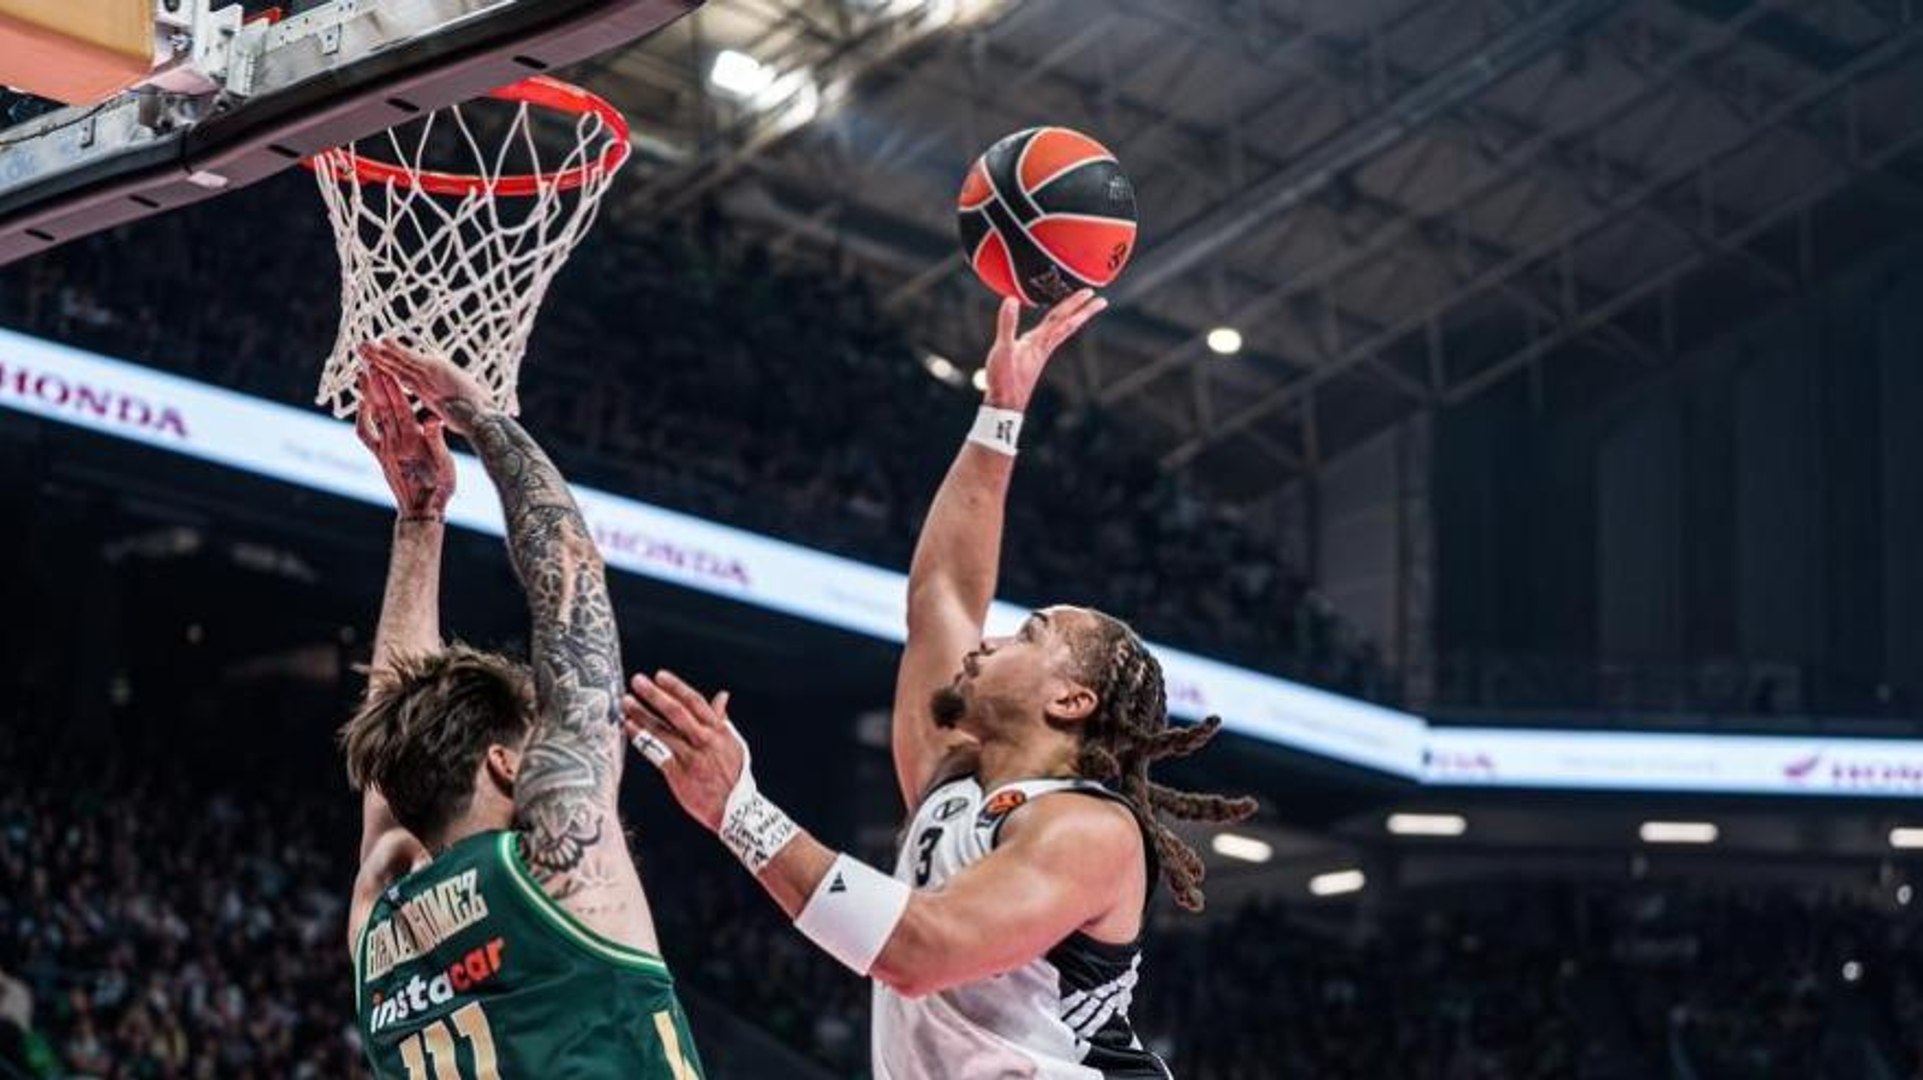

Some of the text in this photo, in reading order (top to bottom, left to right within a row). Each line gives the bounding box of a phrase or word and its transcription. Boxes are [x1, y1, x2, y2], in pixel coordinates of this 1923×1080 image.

[0, 361, 189, 438] HONDA
[915, 826, 945, 888] 3
[371, 936, 506, 1034] instacar
